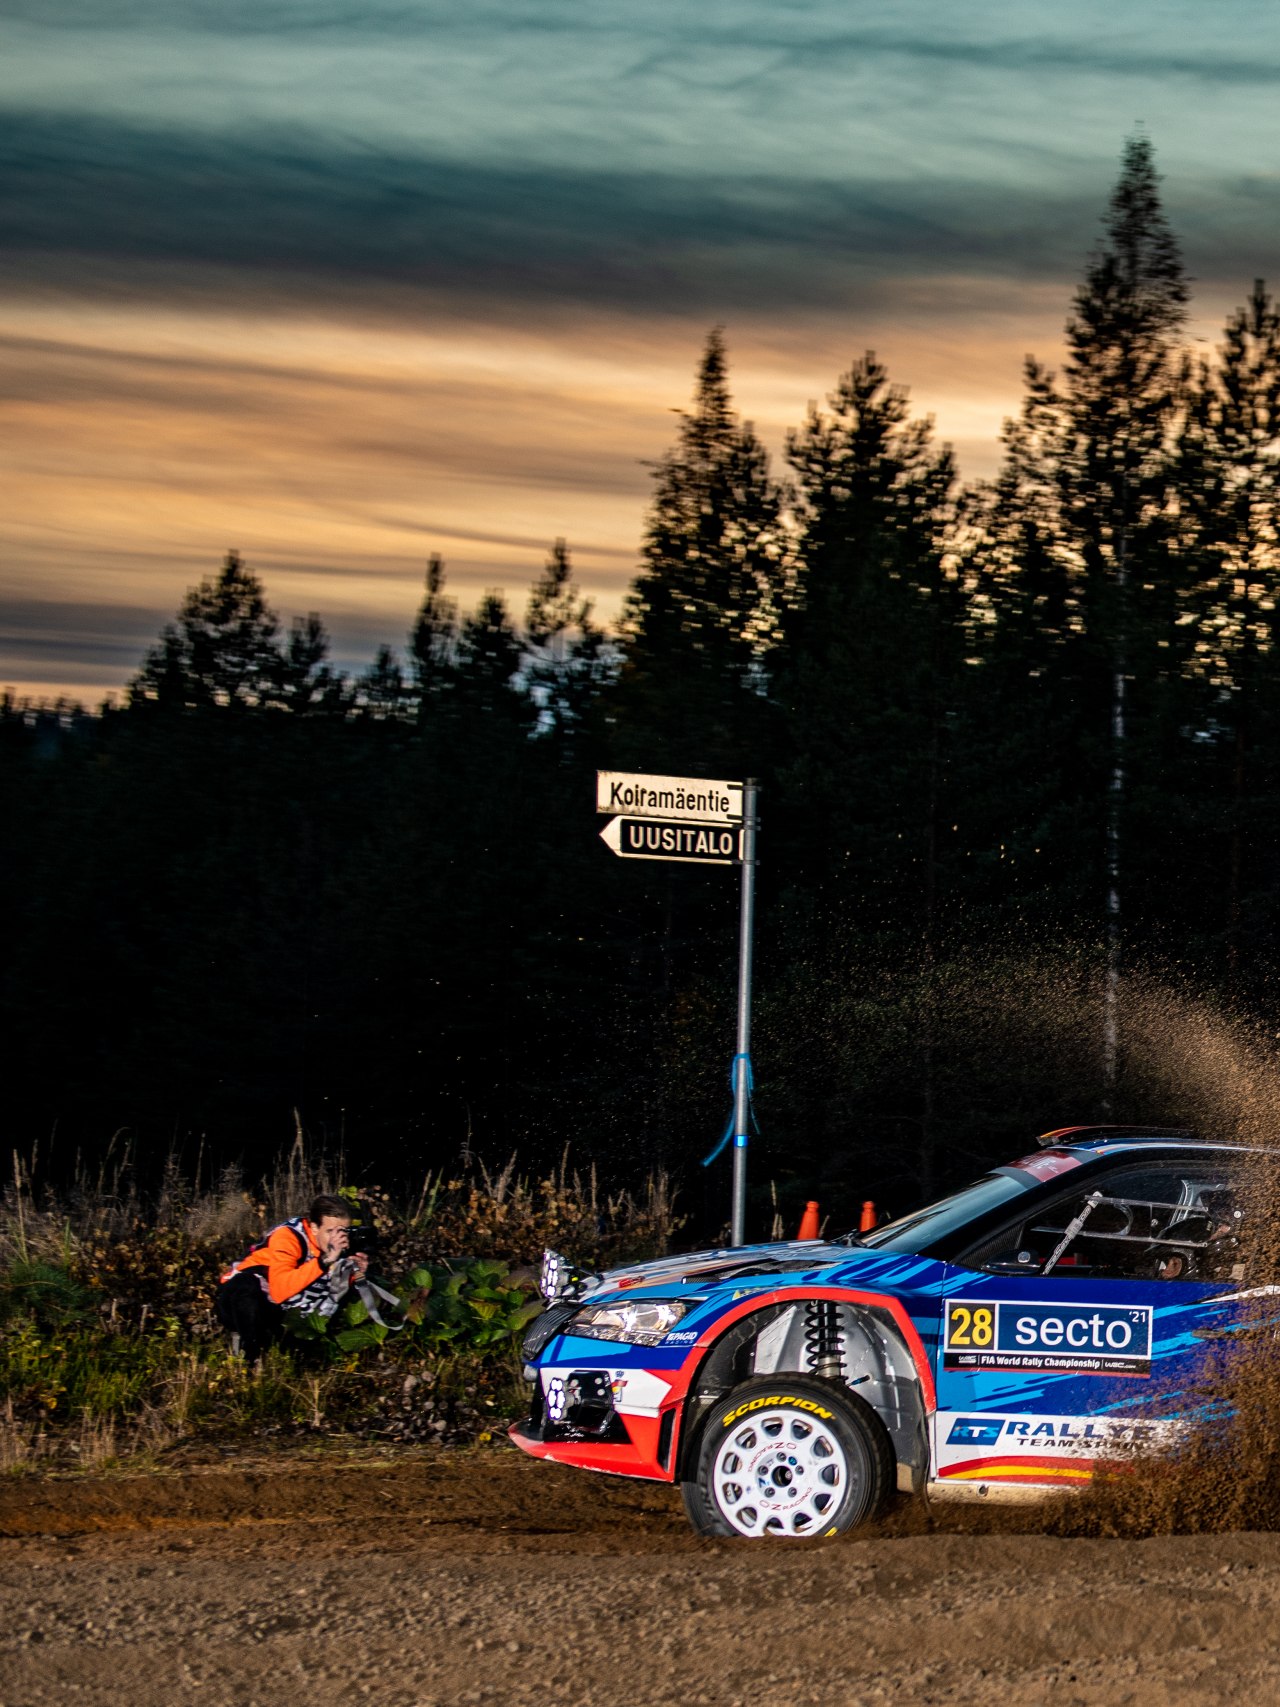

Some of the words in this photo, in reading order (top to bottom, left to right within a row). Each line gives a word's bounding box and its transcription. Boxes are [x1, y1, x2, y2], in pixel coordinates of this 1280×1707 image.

[610, 782, 730, 812] Koiramäentie
[629, 825, 733, 855] UUSITALO
[950, 1307, 992, 1346] 28
[1015, 1313, 1132, 1349] secto
[981, 1355, 995, 1365] FIA
[996, 1356, 1021, 1366] World
[1022, 1357, 1043, 1368] Rally
[1044, 1357, 1101, 1370] Championship
[722, 1395, 833, 1427] SCORPION
[951, 1425, 999, 1438] RTS
[1016, 1438, 1075, 1448] TEAM
